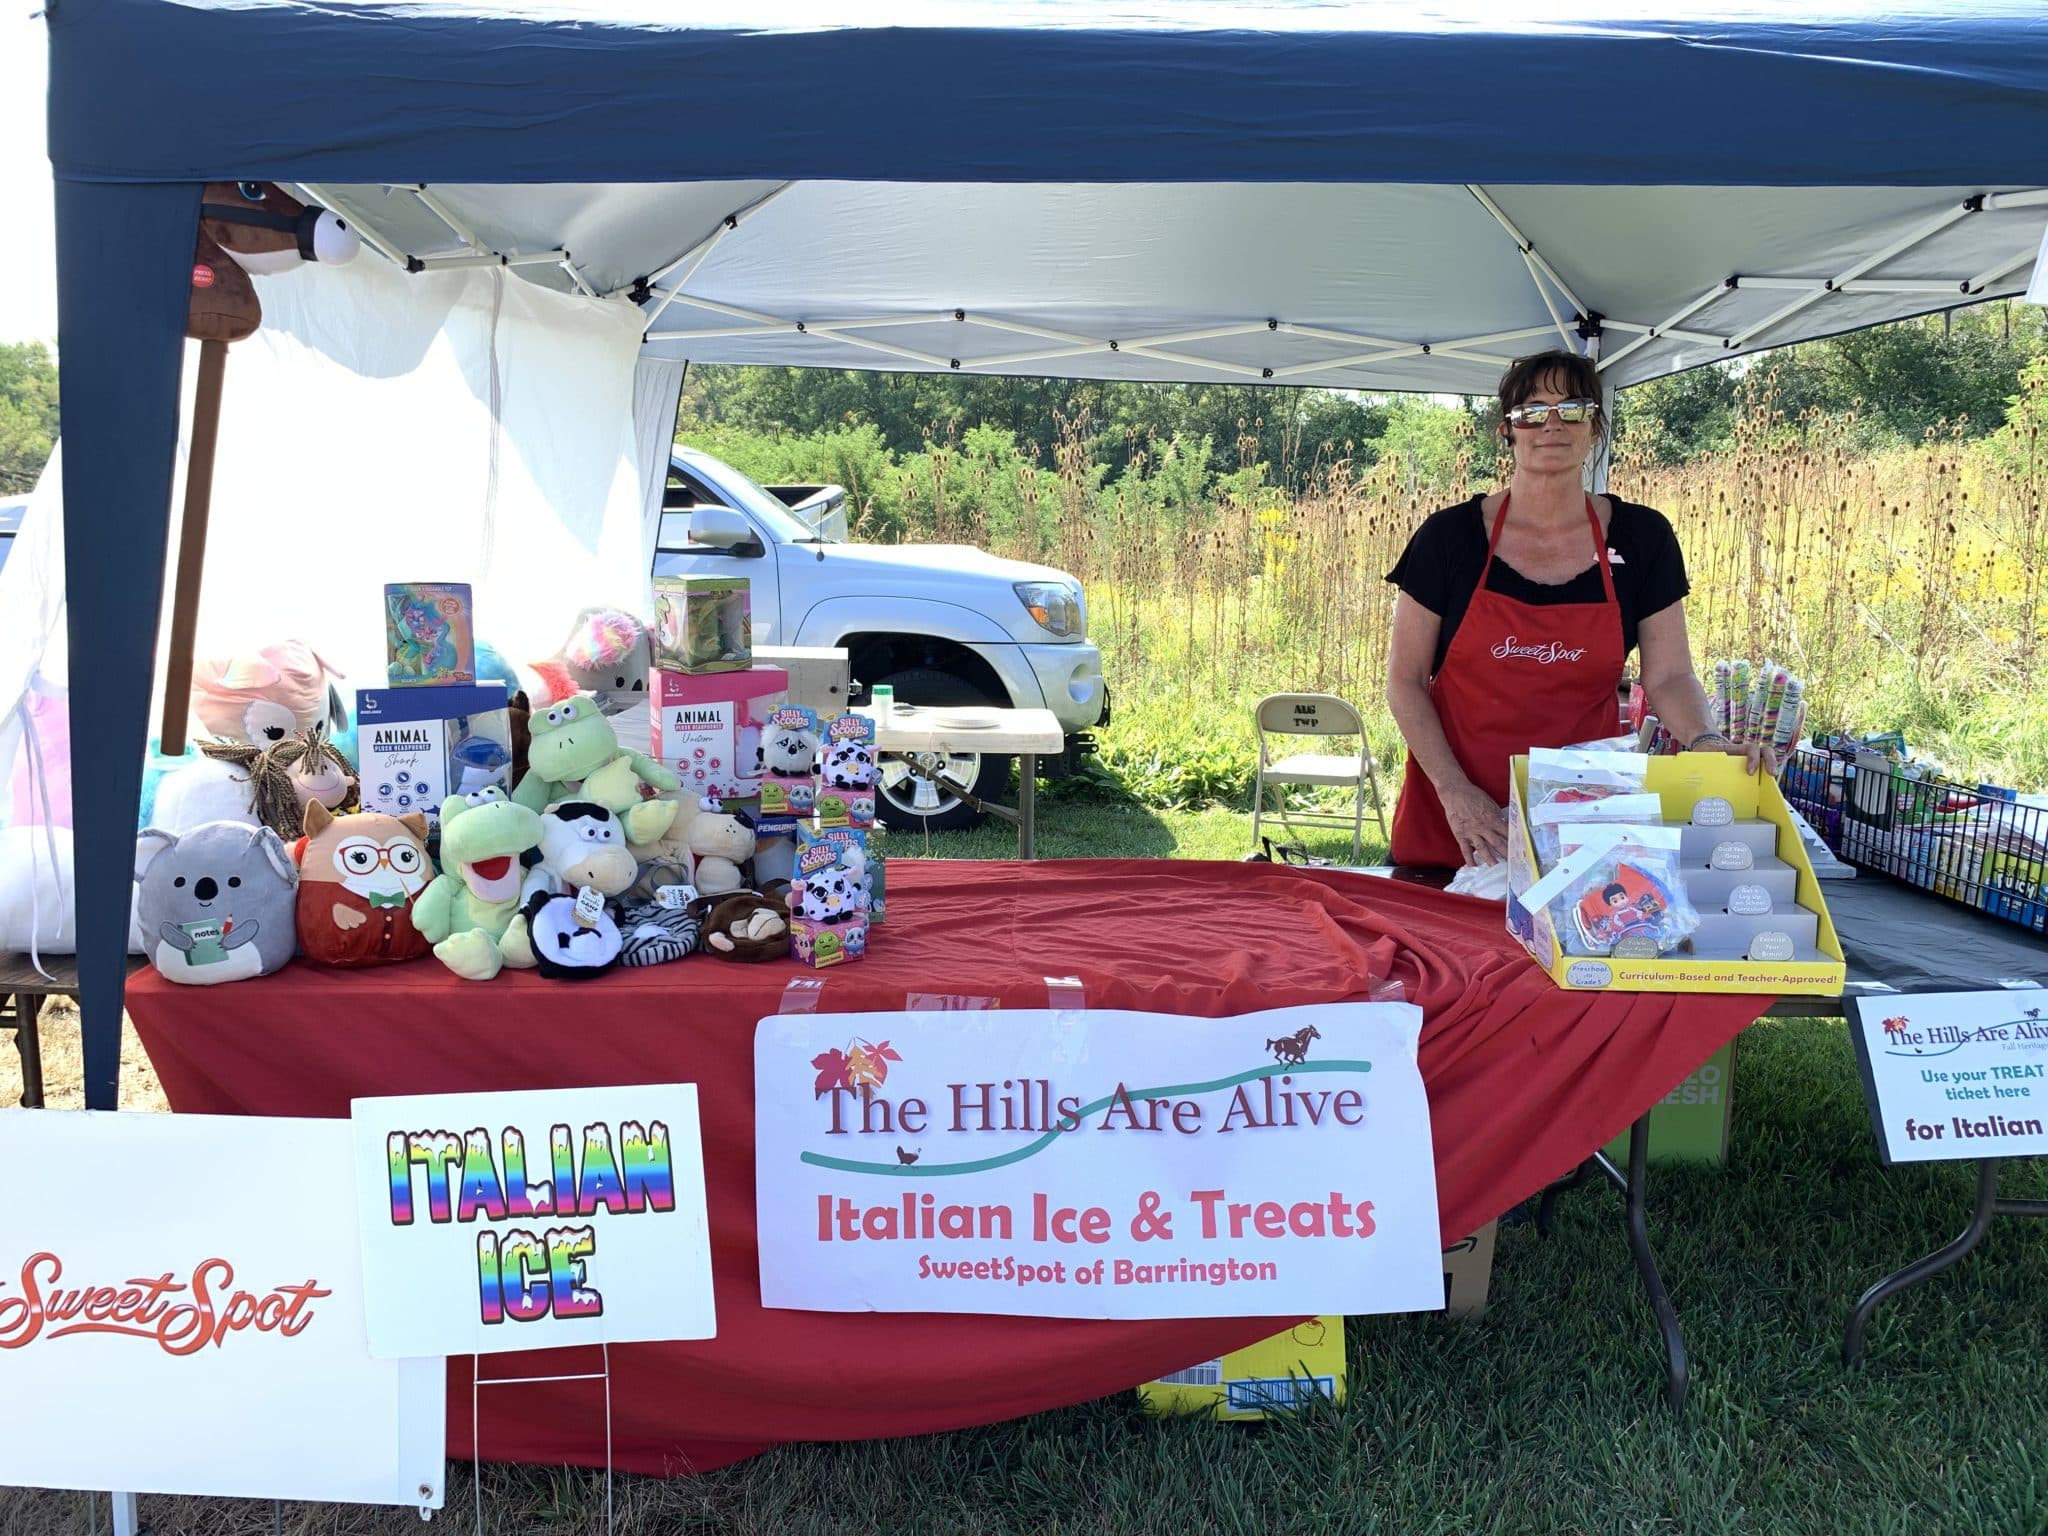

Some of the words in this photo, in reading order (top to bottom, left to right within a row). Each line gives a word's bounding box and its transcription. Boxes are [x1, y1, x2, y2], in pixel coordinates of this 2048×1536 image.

[676, 710, 722, 723] ANIMAL
[1293, 718, 1319, 727] TWP
[374, 729, 429, 743] ANIMAL
[681, 733, 713, 744] Unicorn
[384, 752, 419, 768] Shark
[757, 823, 797, 833] PENGUINS
[801, 852, 838, 867] Scoops
[194, 929, 220, 939] notes
[1619, 971, 1711, 982] Curriculum-Based
[1714, 973, 1734, 981] and
[1738, 973, 1837, 984] Teacher-Approved!
[1888, 1029, 1923, 1046] The
[1926, 1025, 1971, 1044] Hills
[1975, 1025, 2010, 1042] Are
[1920, 1069, 1949, 1084] Use
[1952, 1070, 1987, 1084] your
[1990, 1064, 2044, 1080] TREAT
[1658, 1086, 1719, 1104] ESH
[1945, 1086, 1991, 1101] ticket
[1993, 1084, 2031, 1099] here
[821, 1082, 928, 1136] The
[946, 1079, 1082, 1134] Hills
[1097, 1081, 1203, 1136] Are
[1217, 1075, 1365, 1134] Alive
[1905, 1118, 1945, 1141] for
[1952, 1115, 2044, 1139] Italian
[386, 1120, 676, 1226] ITALIAN
[817, 1192, 1013, 1243] Italian
[1032, 1192, 1112, 1244] Ice
[1130, 1190, 1173, 1242] &
[1190, 1189, 1377, 1240] Treats
[476, 1225, 604, 1326] ICE
[917, 1255, 1066, 1287] SweetSpot
[1074, 1259, 1105, 1286] of
[1114, 1258, 1278, 1286] Barrington
